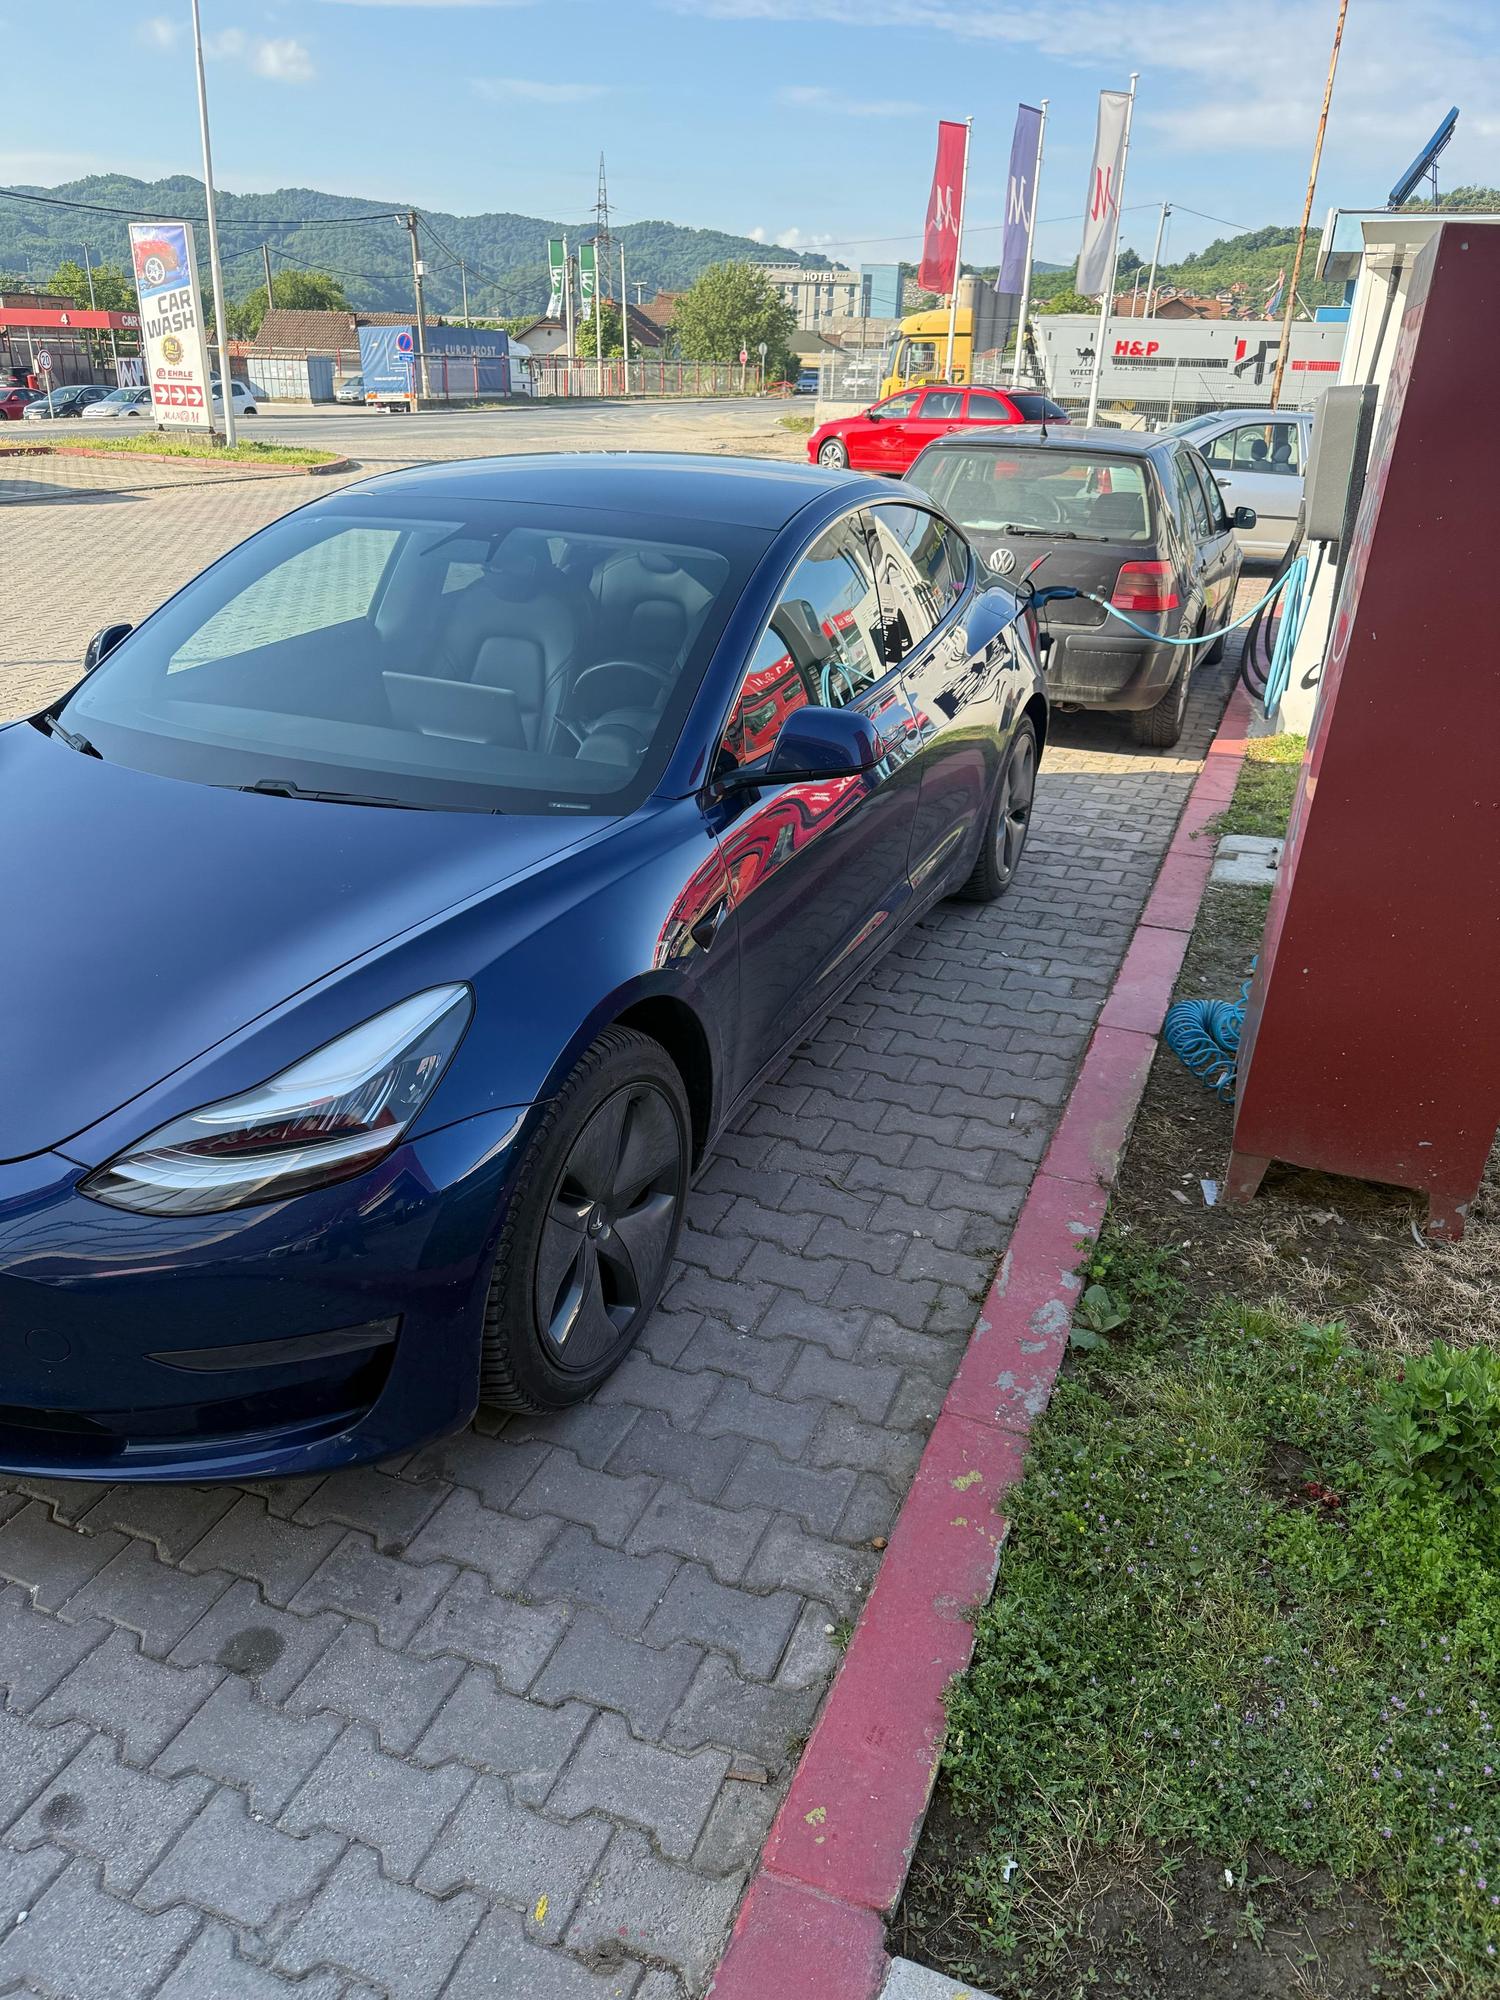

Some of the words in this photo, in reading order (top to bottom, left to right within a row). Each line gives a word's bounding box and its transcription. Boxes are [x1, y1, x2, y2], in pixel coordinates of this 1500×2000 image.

[802, 272, 836, 282] HOTEL
[157, 289, 192, 315] CAR
[60, 312, 69, 325] 4
[121, 315, 139, 327] CAR
[146, 309, 195, 339] WASH
[445, 344, 468, 355] EURO
[1114, 340, 1160, 356] H&P
[41, 354, 51, 367] 20
